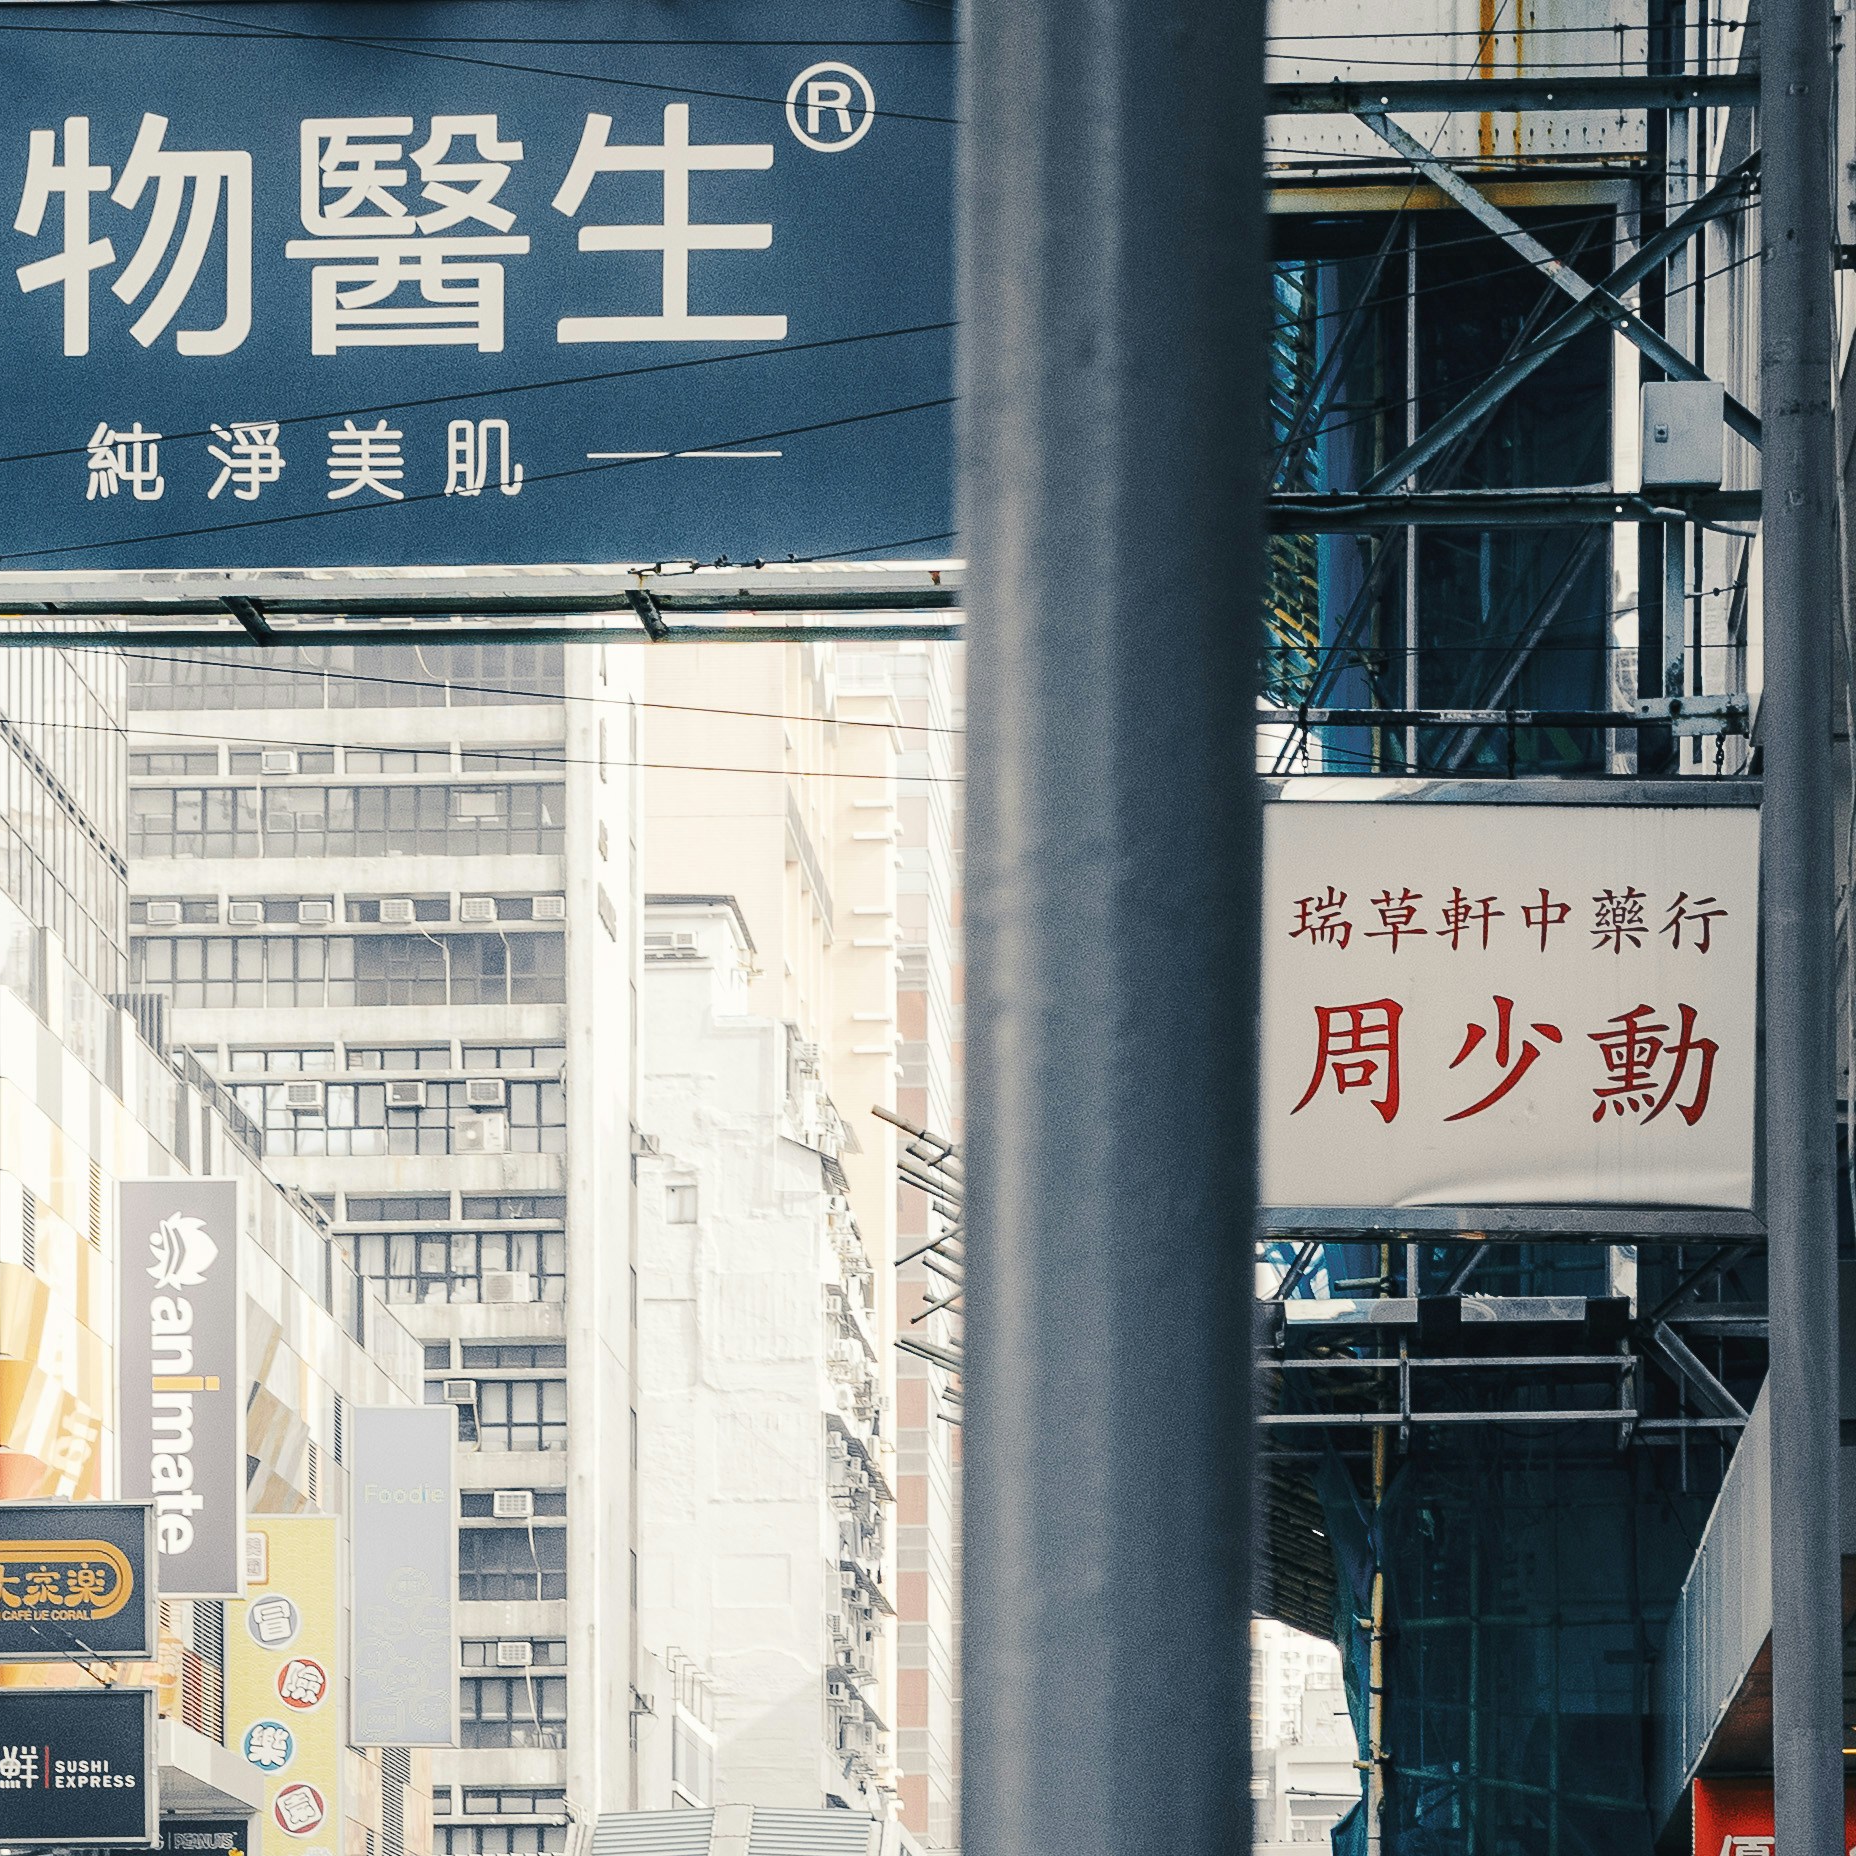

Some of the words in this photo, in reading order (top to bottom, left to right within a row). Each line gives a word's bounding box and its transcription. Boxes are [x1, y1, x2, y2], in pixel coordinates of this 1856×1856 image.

[86, 418, 524, 501] 純淨美肌
[1289, 885, 1729, 955] 瑞草軒中藥行
[150, 1295, 221, 1556] animate
[50, 1609, 91, 1621] CORAL
[54, 1760, 109, 1774] SUSHI
[54, 1774, 136, 1789] EXPRESS
